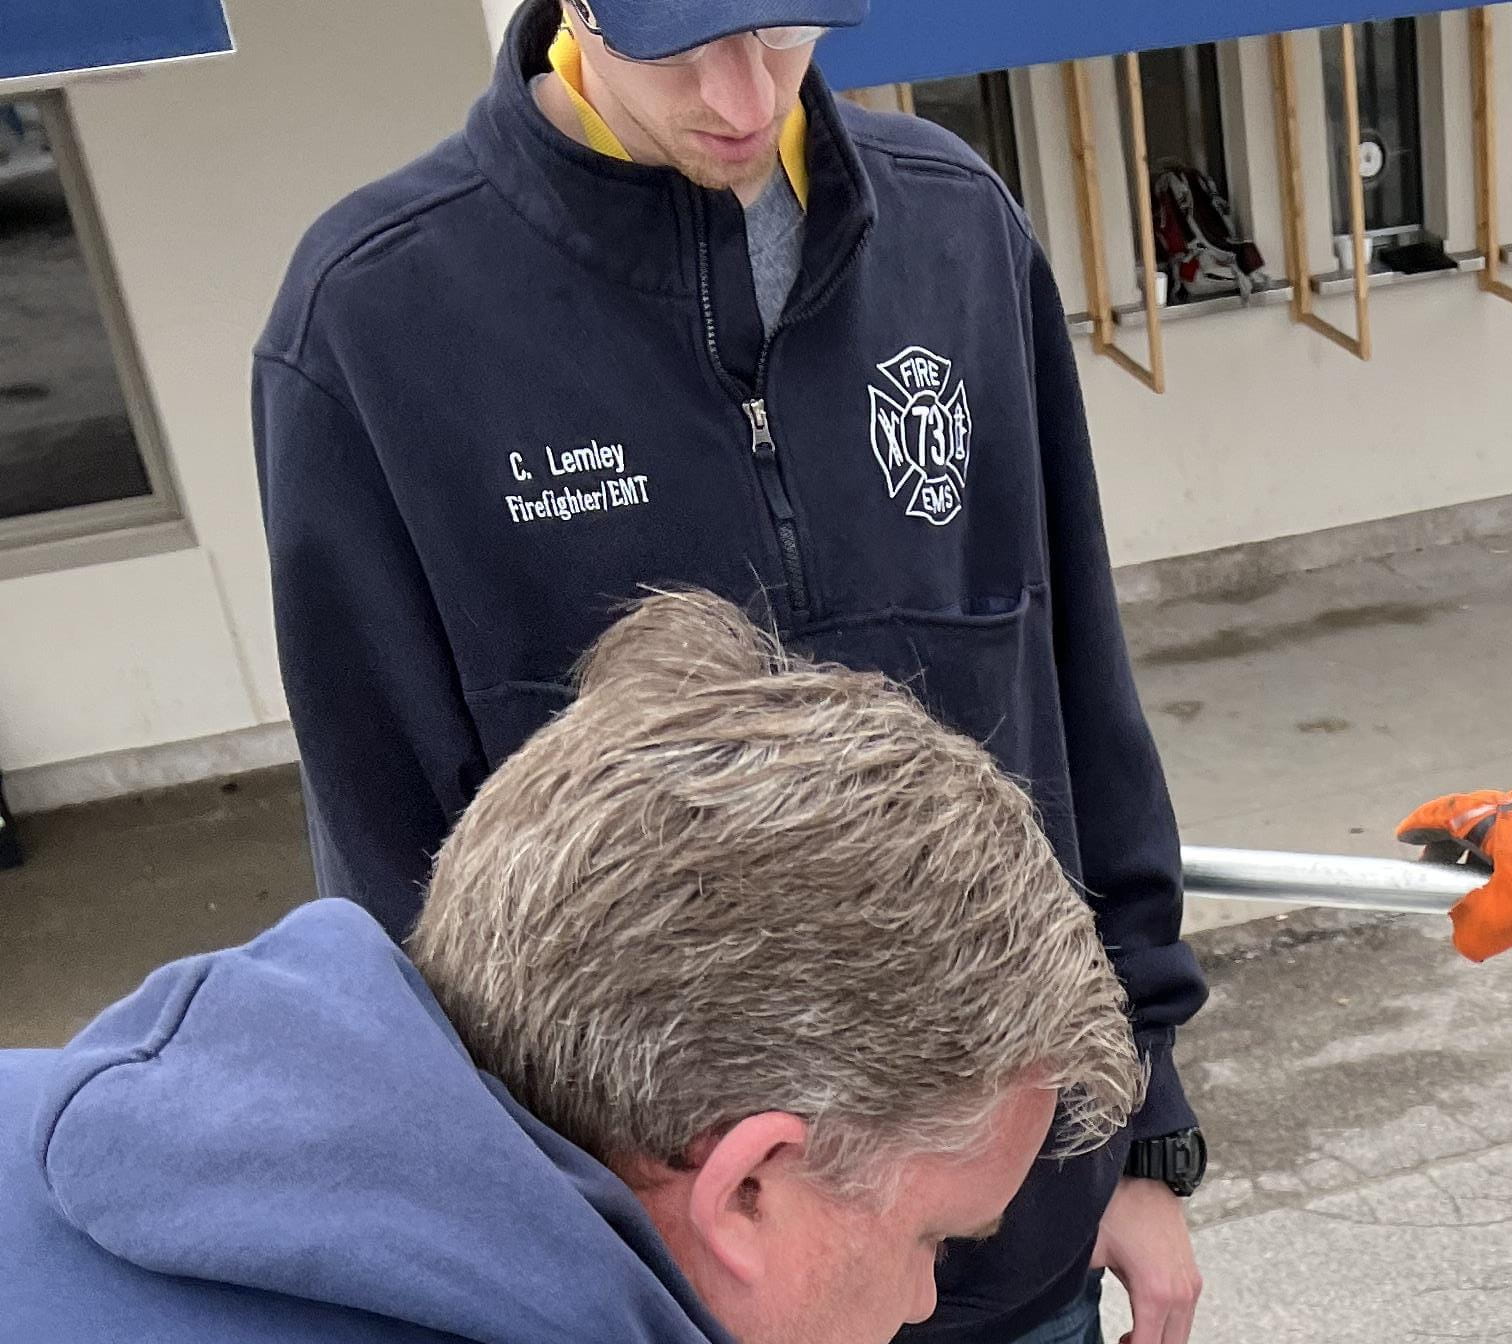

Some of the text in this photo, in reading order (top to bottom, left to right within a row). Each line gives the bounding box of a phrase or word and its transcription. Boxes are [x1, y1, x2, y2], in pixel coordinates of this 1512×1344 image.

[900, 358, 940, 388] FIRE
[912, 404, 946, 468] 73
[509, 439, 625, 481] C. Lemley
[505, 475, 649, 523] Firefighter/EMT
[922, 485, 954, 514] EMS
